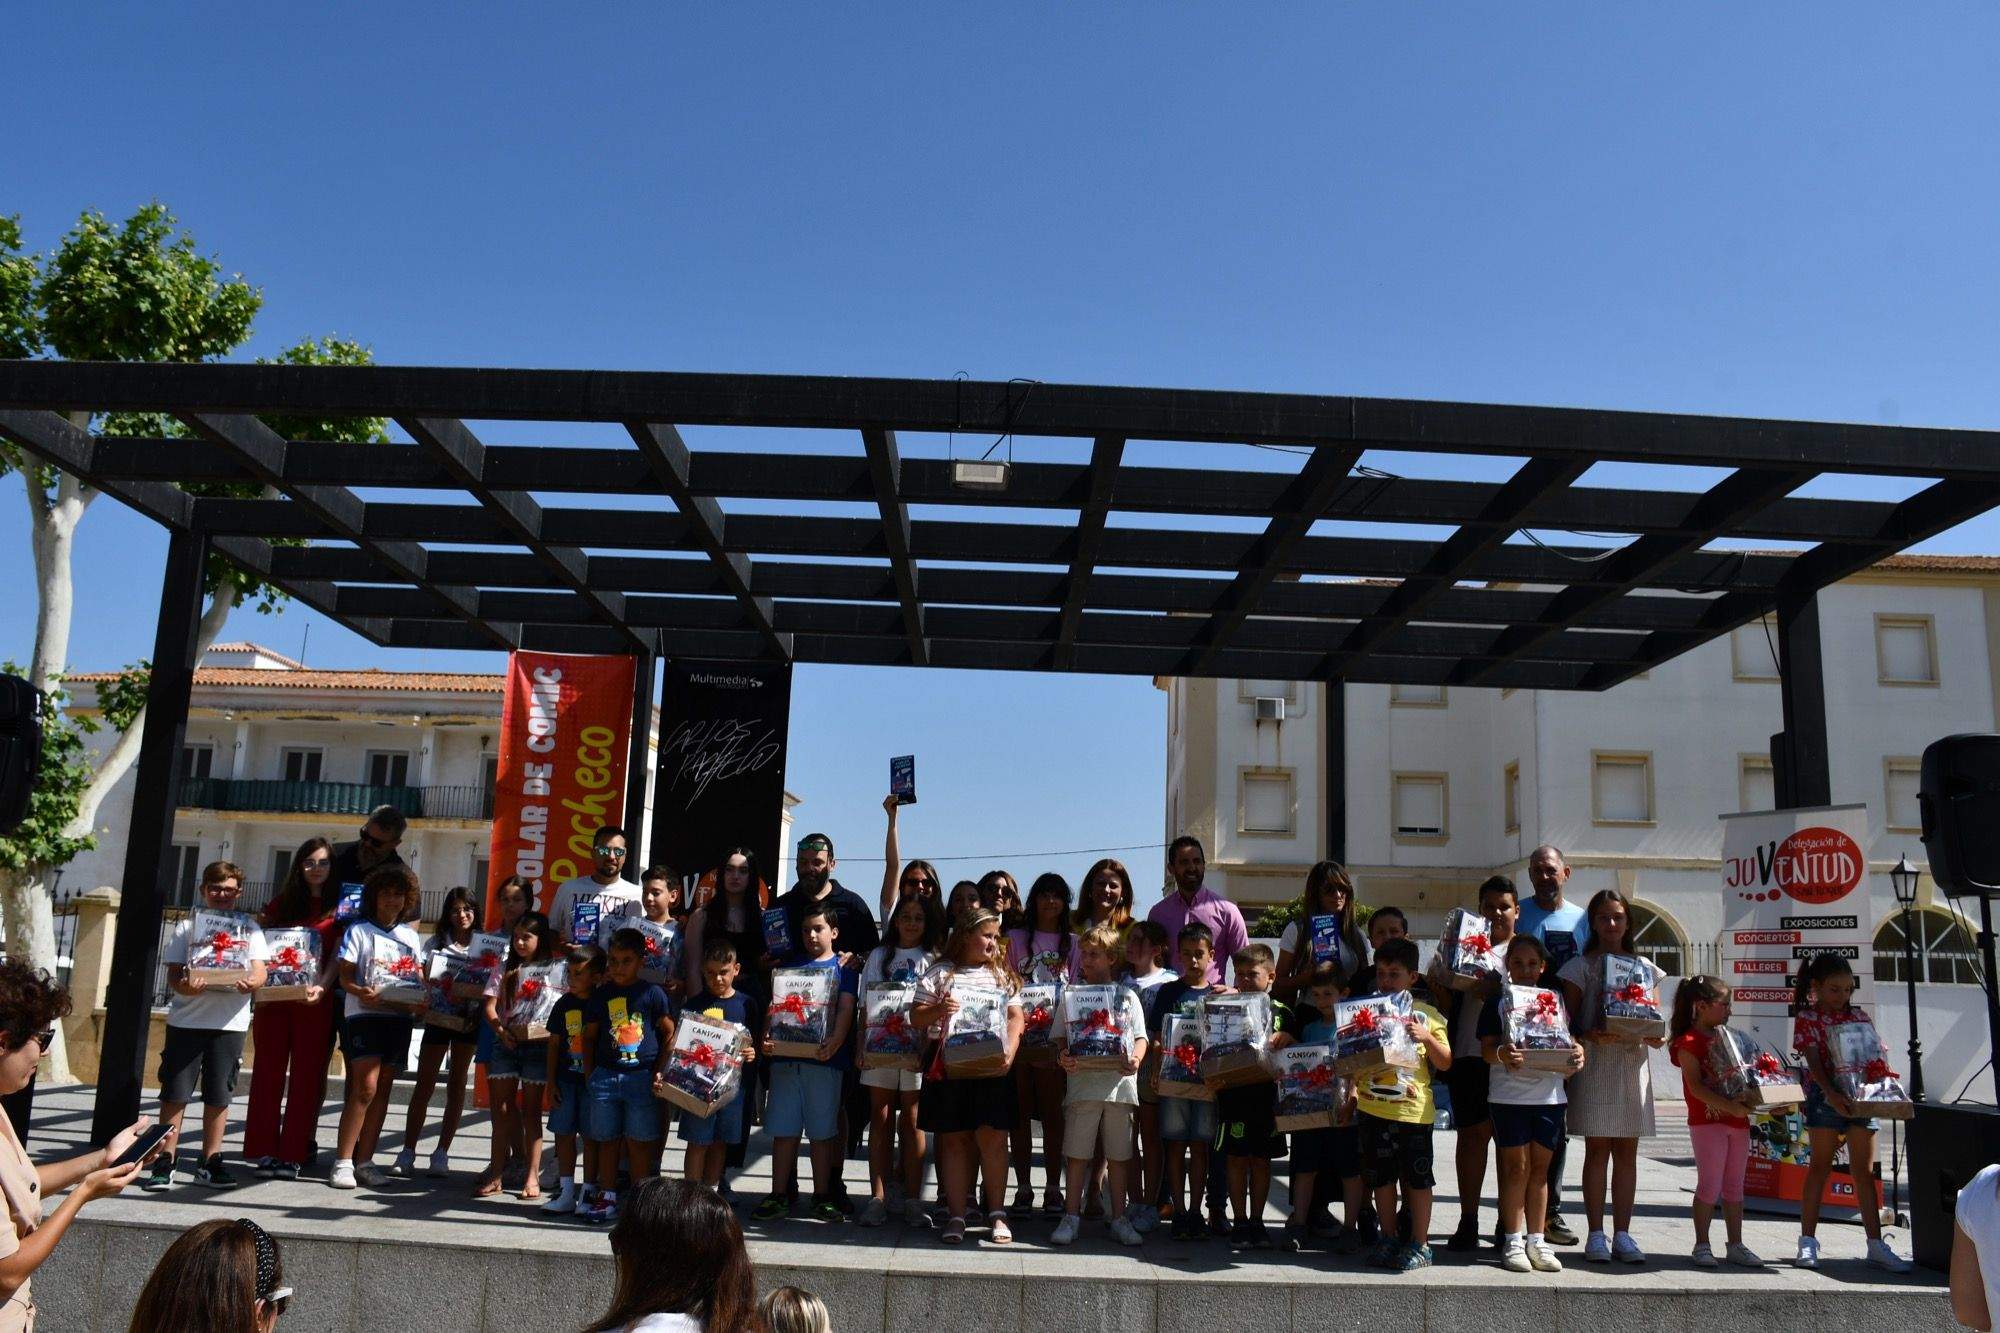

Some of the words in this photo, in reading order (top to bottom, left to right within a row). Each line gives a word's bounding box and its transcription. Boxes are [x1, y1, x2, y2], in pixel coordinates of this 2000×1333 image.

[690, 673, 747, 685] Multimedia
[526, 666, 562, 753] COMIC
[522, 761, 553, 796] DE
[1788, 836, 1834, 851] Delegación
[1837, 835, 1847, 847] de
[515, 804, 548, 912] OLAR
[1726, 840, 1856, 887] JUVENTUD
[1783, 918, 1855, 928] EXPOSICIONES
[1737, 933, 1796, 943] CONCIERTOS
[1796, 947, 1855, 957] FORMCIÓN
[1615, 962, 1632, 972] CANSO
[1738, 962, 1782, 972] TALLERES
[785, 980, 814, 988] CANSON
[1019, 990, 1046, 999] CANSON
[1076, 995, 1103, 1004] CANSON
[1181, 1023, 1197, 1031] CANS
[692, 1026, 721, 1040] CANSON
[1286, 1050, 1318, 1059] CANSON
